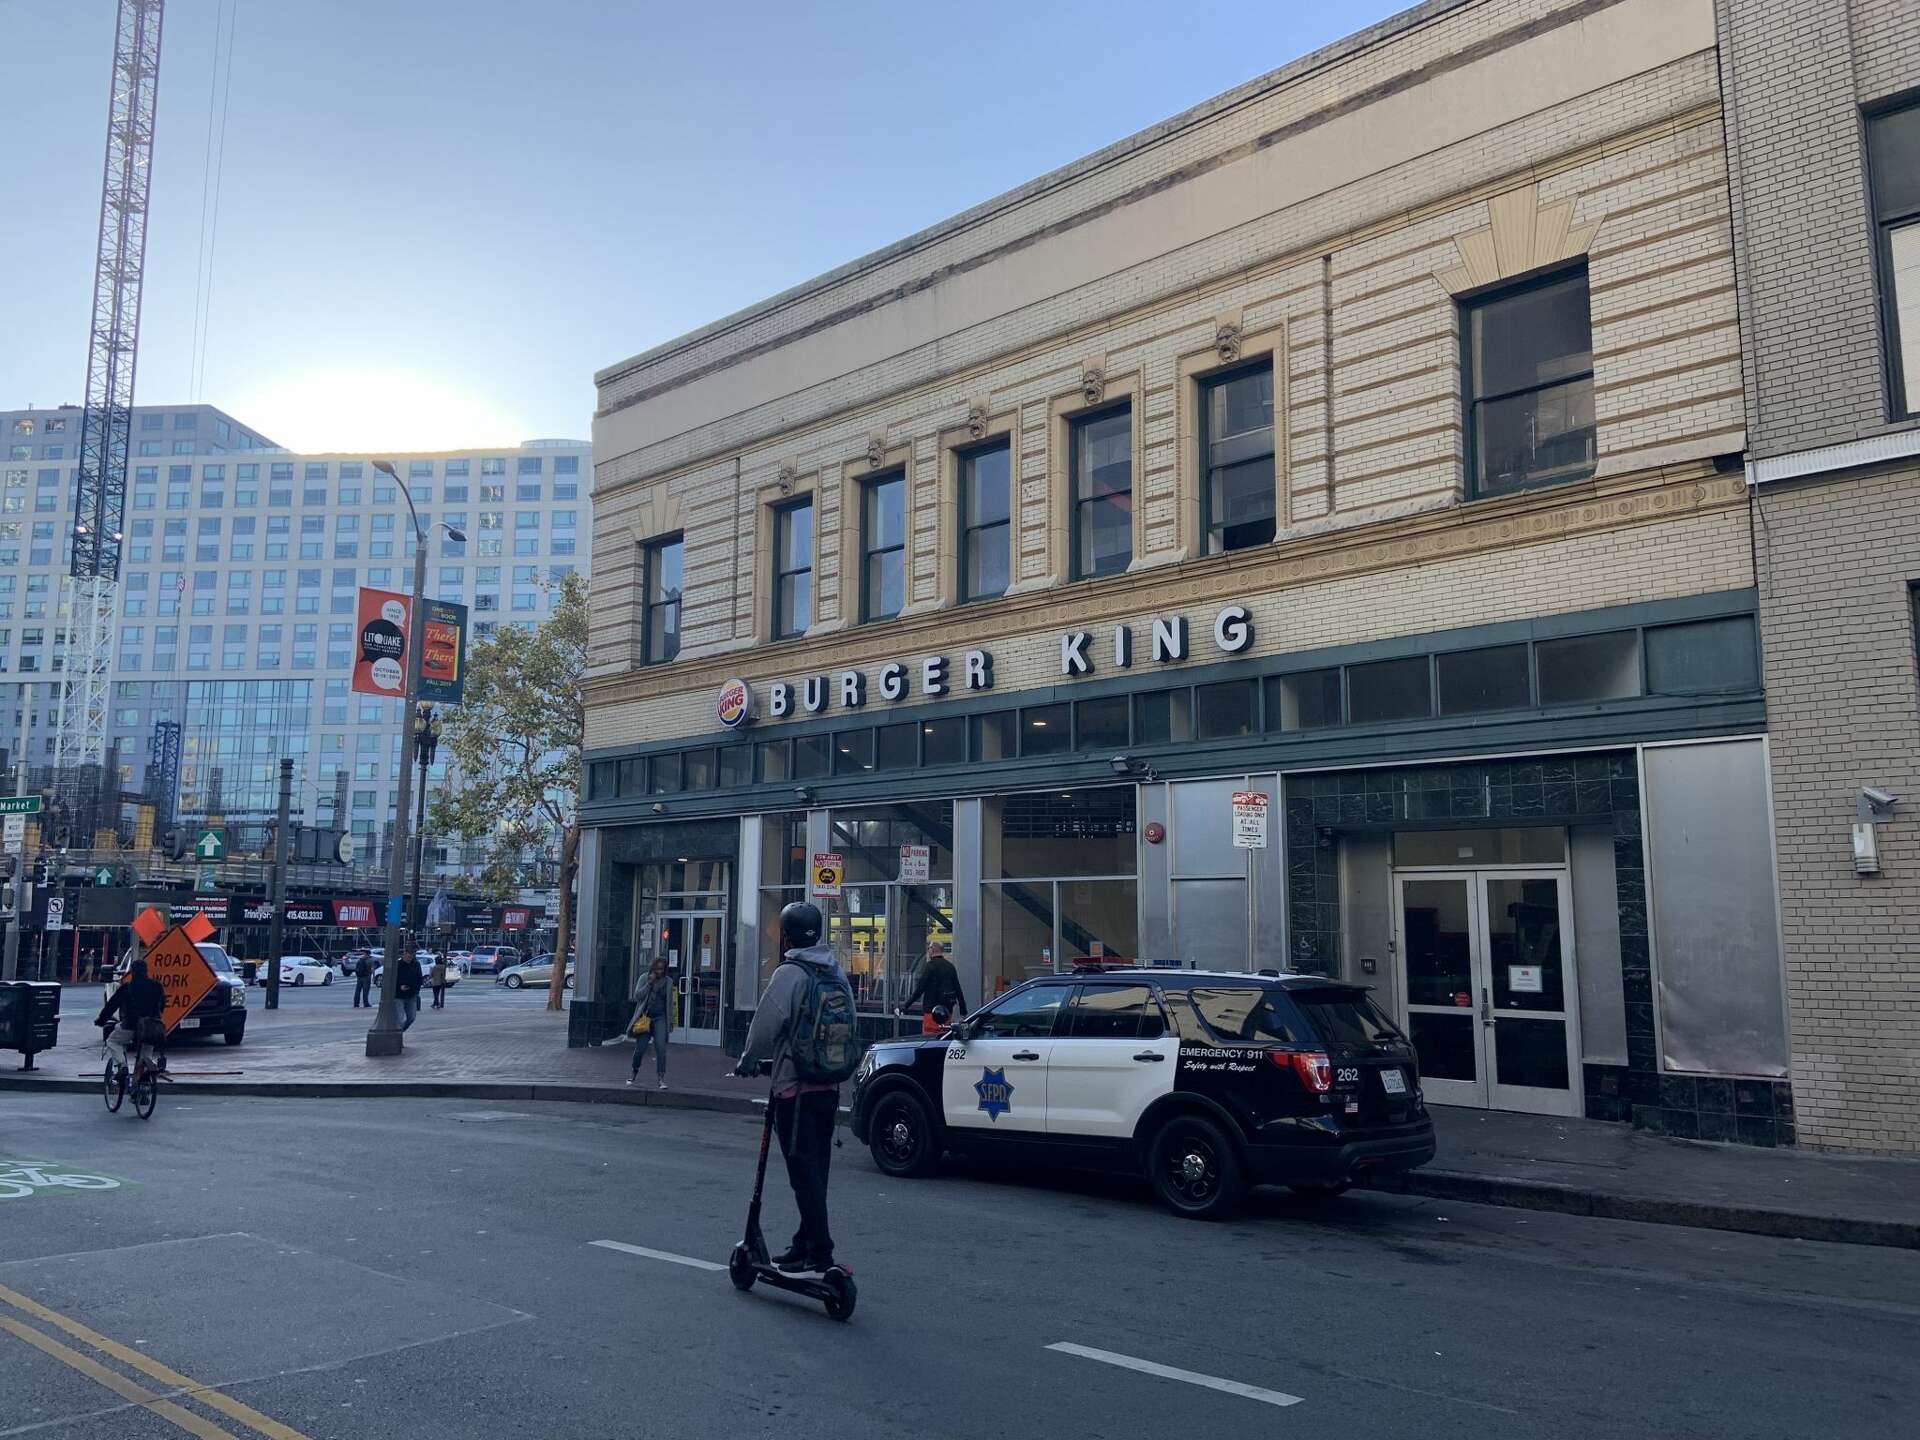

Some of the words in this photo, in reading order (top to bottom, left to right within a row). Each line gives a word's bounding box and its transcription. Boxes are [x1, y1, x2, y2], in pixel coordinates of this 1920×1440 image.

[364, 631, 402, 647] LITQUAKE
[427, 627, 456, 642] There
[425, 648, 455, 663] There
[770, 650, 993, 717] BURGER
[1061, 605, 1254, 675] KING
[719, 685, 744, 701] BURGER
[717, 693, 744, 718] KING
[0, 800, 31, 811] Market
[902, 846, 911, 857] NO
[911, 849, 928, 857] PARKING
[286, 910, 324, 920] 415.433.3333
[348, 906, 370, 921] TRINITY
[154, 953, 191, 967] ROAD
[164, 994, 191, 1008] EAD
[948, 1048, 967, 1060] 262
[1179, 1047, 1243, 1059] EMERGENCY
[1246, 1050, 1263, 1060] 911
[1183, 1060, 1208, 1071] Safety
[1209, 1062, 1227, 1071] with
[1227, 1062, 1257, 1073] Respect
[1337, 1067, 1359, 1081] 262
[980, 1083, 1008, 1103] SFPD
